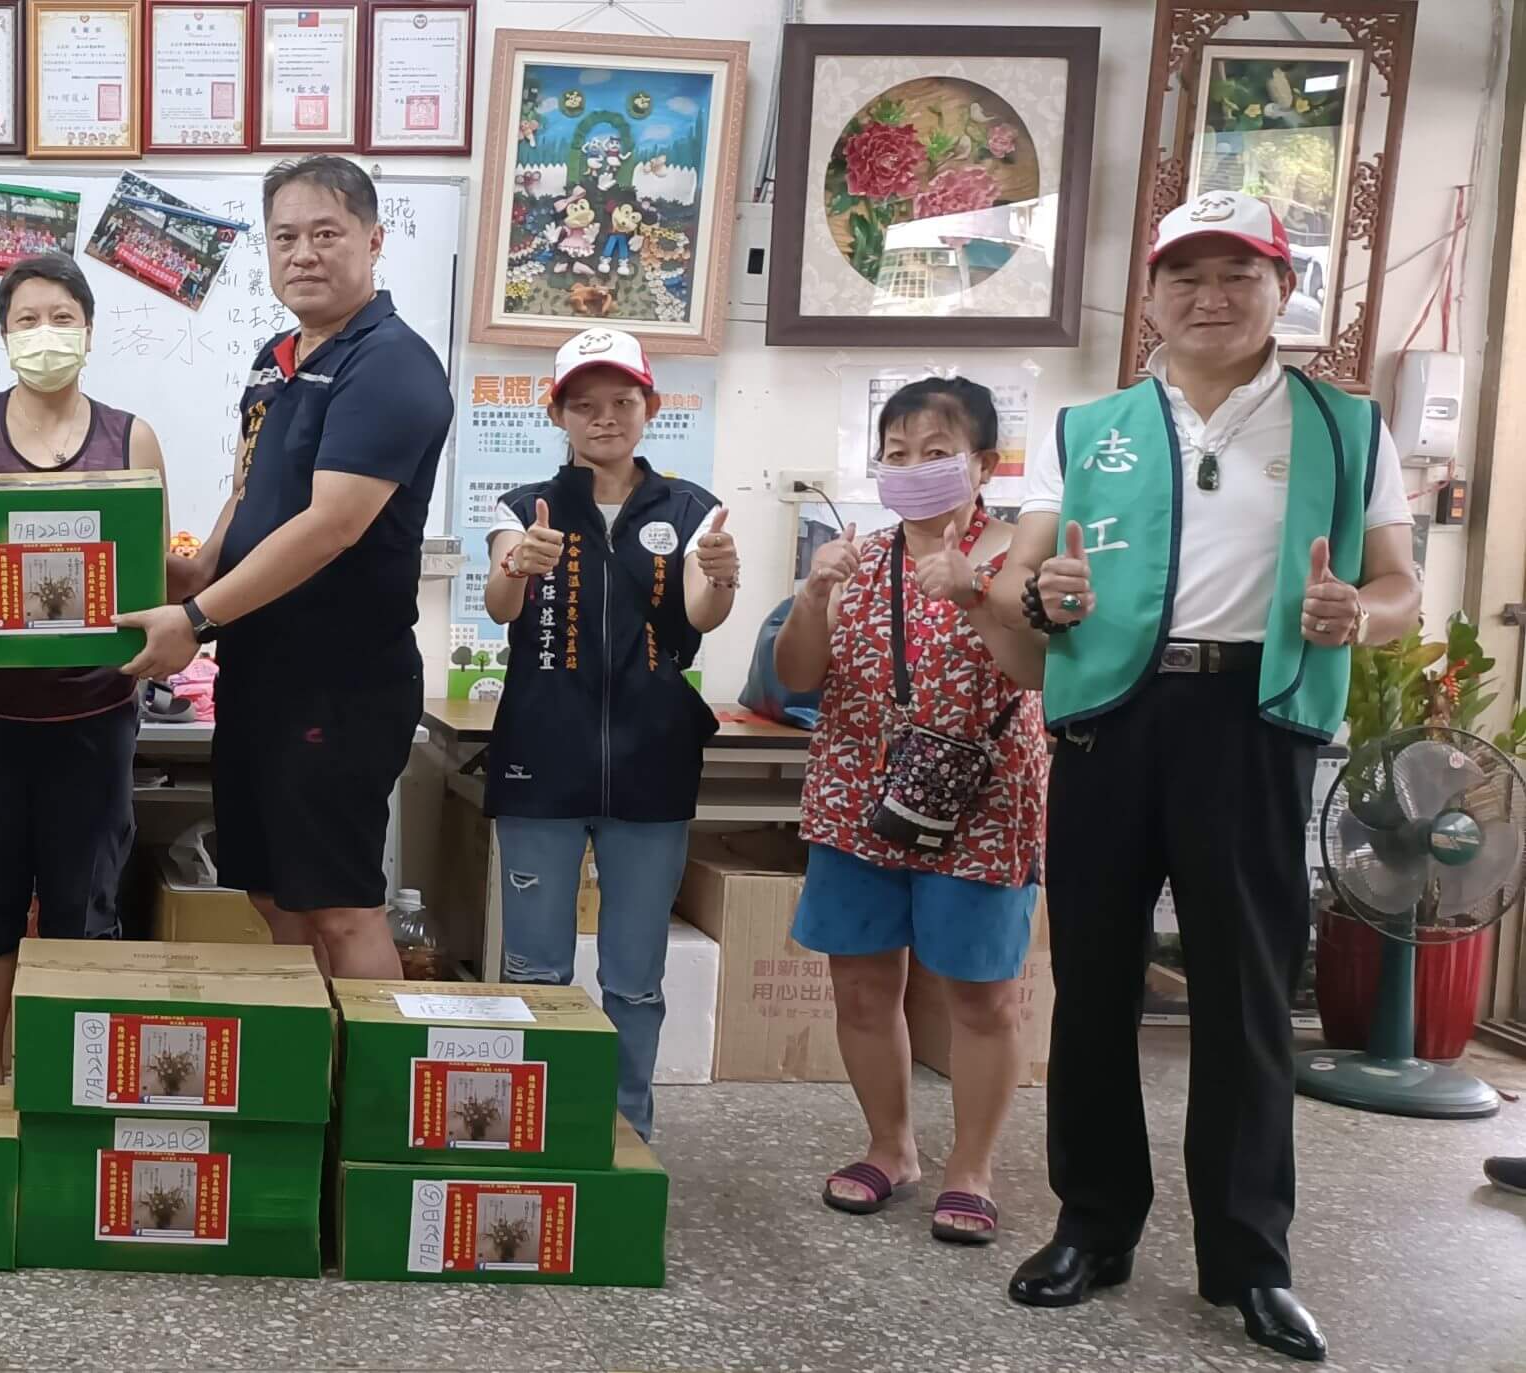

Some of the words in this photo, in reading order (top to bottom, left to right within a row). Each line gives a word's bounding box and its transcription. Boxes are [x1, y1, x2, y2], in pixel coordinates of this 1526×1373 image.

[1083, 428, 1139, 554] 志工
[14, 521, 71, 541] 7月22日
[433, 1040, 490, 1060] 7月22日
[85, 1042, 105, 1101] 7月22日
[121, 1130, 179, 1150] 7月22日
[419, 1209, 441, 1266] 7月22日
